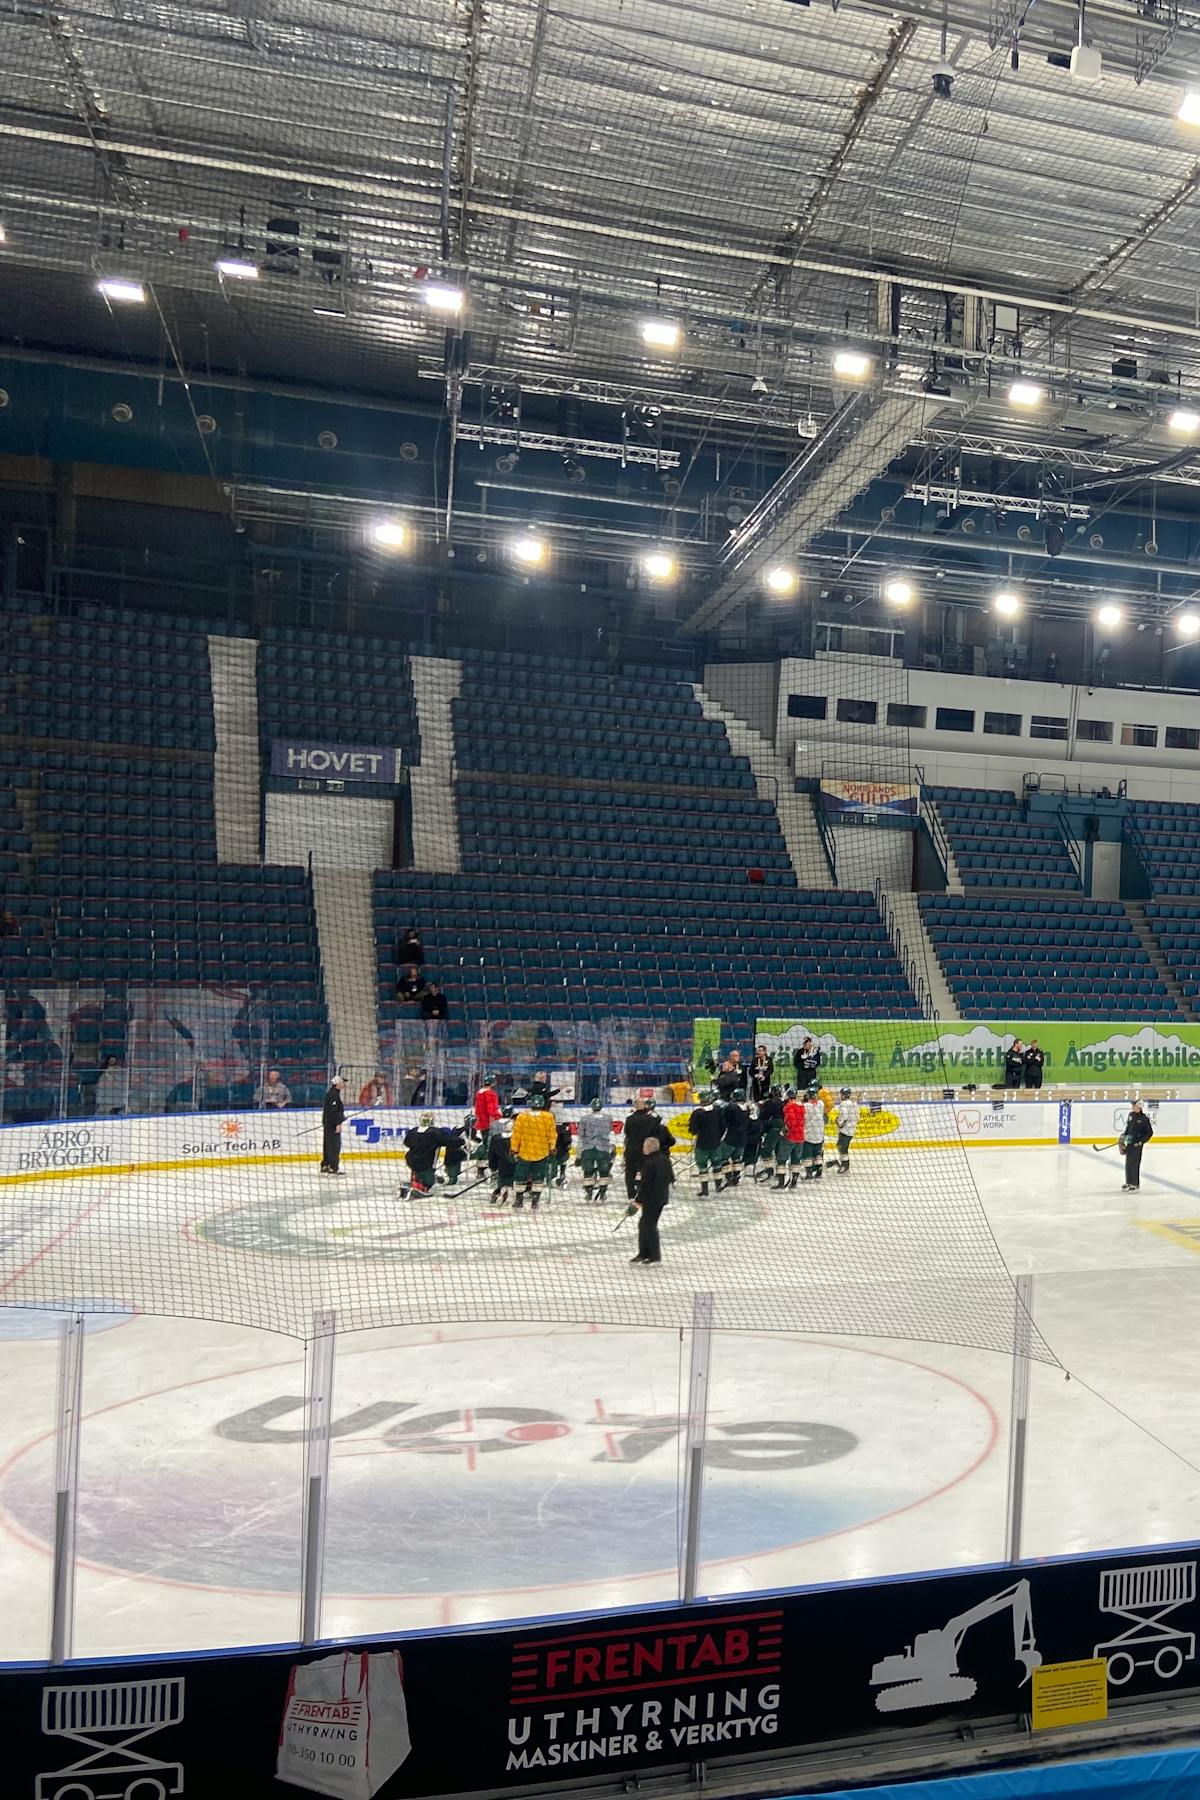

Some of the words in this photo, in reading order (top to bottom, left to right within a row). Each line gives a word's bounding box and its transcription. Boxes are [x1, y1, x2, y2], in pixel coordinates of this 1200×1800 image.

[287, 747, 384, 774] HOVET
[842, 783, 897, 796] NORRLANDS
[889, 1040, 1053, 1072] Ångtvättbn
[983, 1114, 1016, 1123] ATHLETIC
[983, 1121, 1005, 1129] WORK
[39, 1128, 92, 1150] ÅBRO
[182, 1142, 218, 1155] Solar
[225, 1140, 257, 1153] Tech
[262, 1138, 281, 1150] AB
[18, 1145, 111, 1171] BRYGGERI
[546, 1628, 750, 1688] FRENTAB
[297, 1703, 350, 1720] FRENTAB
[507, 1684, 781, 1746] UTHYRNING
[286, 1721, 358, 1741] UTHYRNING
[505, 1734, 638, 1771] MASKINER
[645, 1730, 663, 1752] &
[670, 1713, 778, 1747] VERKTYG
[319, 1751, 335, 1765] 10
[338, 1753, 356, 1768] 00
